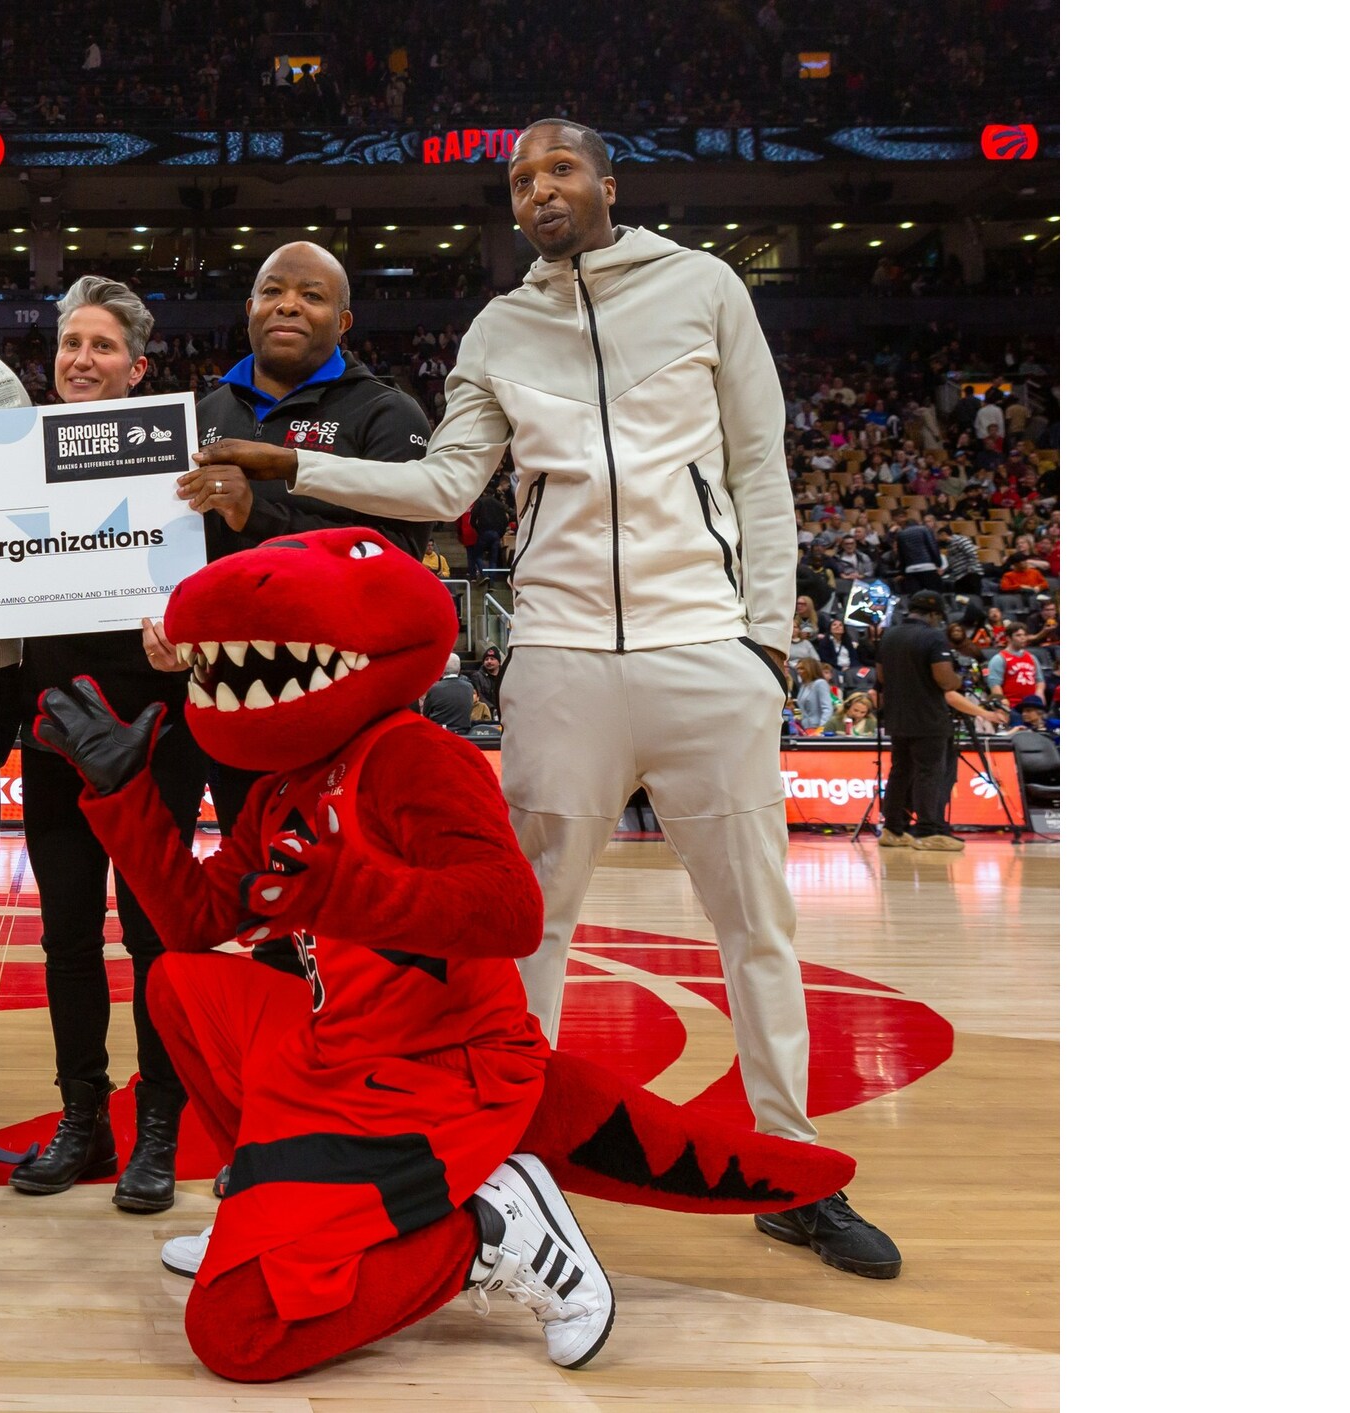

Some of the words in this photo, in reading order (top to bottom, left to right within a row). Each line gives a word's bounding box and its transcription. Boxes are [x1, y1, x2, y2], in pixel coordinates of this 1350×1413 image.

[423, 128, 524, 164] RAPTO
[15, 310, 39, 323] 119
[57, 422, 119, 442] BOROUGH
[290, 420, 340, 433] GRASS
[58, 437, 120, 458] BALLERS
[409, 433, 429, 448] COA
[83, 460, 115, 469] DIFFERENCE
[158, 454, 177, 462] COURT.
[27, 592, 83, 603] CORPORATION
[85, 590, 102, 598] AND
[104, 589, 118, 597] THE
[120, 586, 158, 596] TORONTO
[1016, 671, 1035, 685] 43
[779, 770, 888, 805] Tanger
